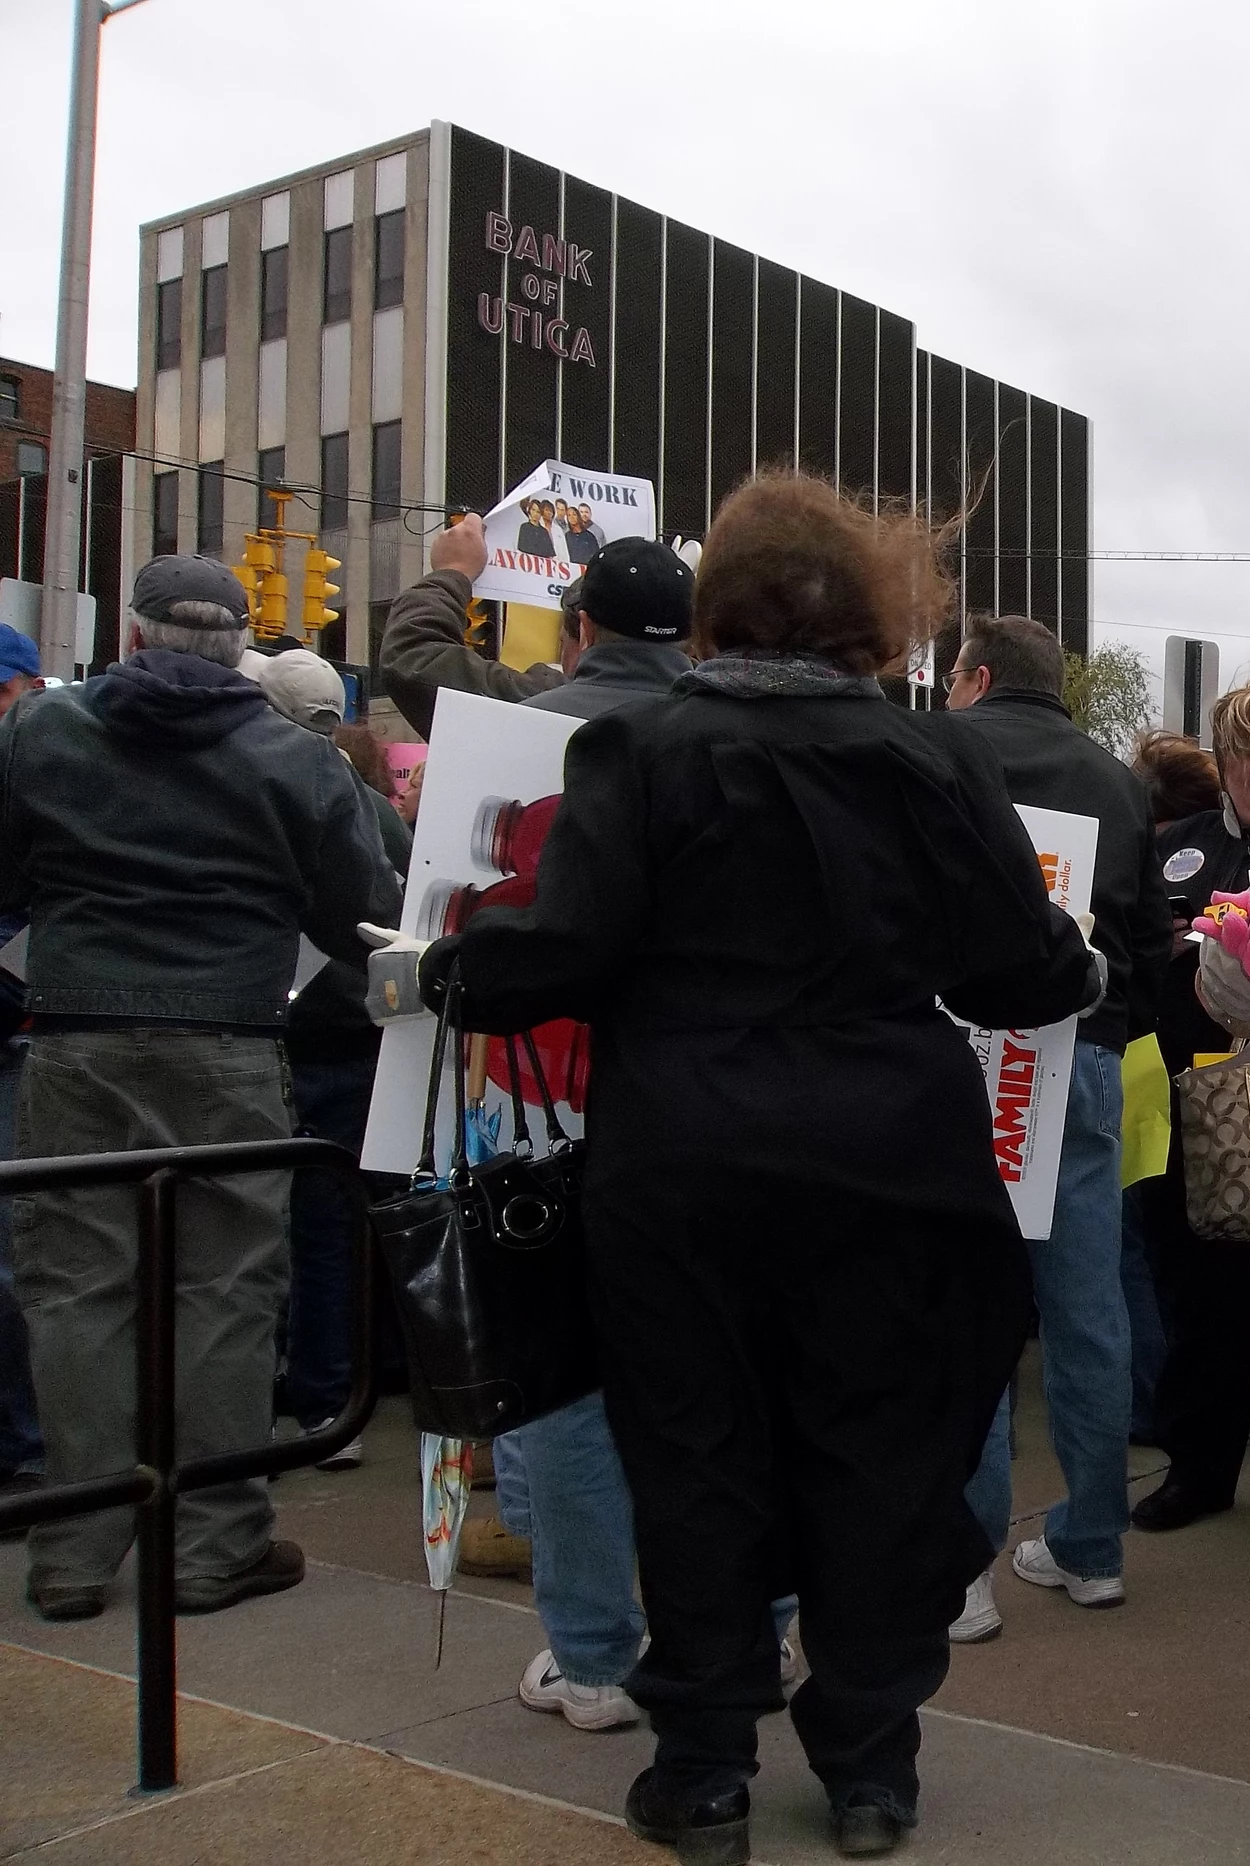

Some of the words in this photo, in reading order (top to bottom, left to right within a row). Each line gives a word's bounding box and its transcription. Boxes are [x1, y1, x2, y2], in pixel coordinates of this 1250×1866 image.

[486, 211, 594, 287] BANK
[522, 273, 558, 306] OF
[478, 292, 596, 368] UTICA
[543, 472, 562, 494] E
[569, 477, 638, 508] WORK
[488, 548, 571, 581] AYOFFS
[1058, 858, 1073, 892] dollar.
[993, 1038, 1038, 1184] FAMILY
